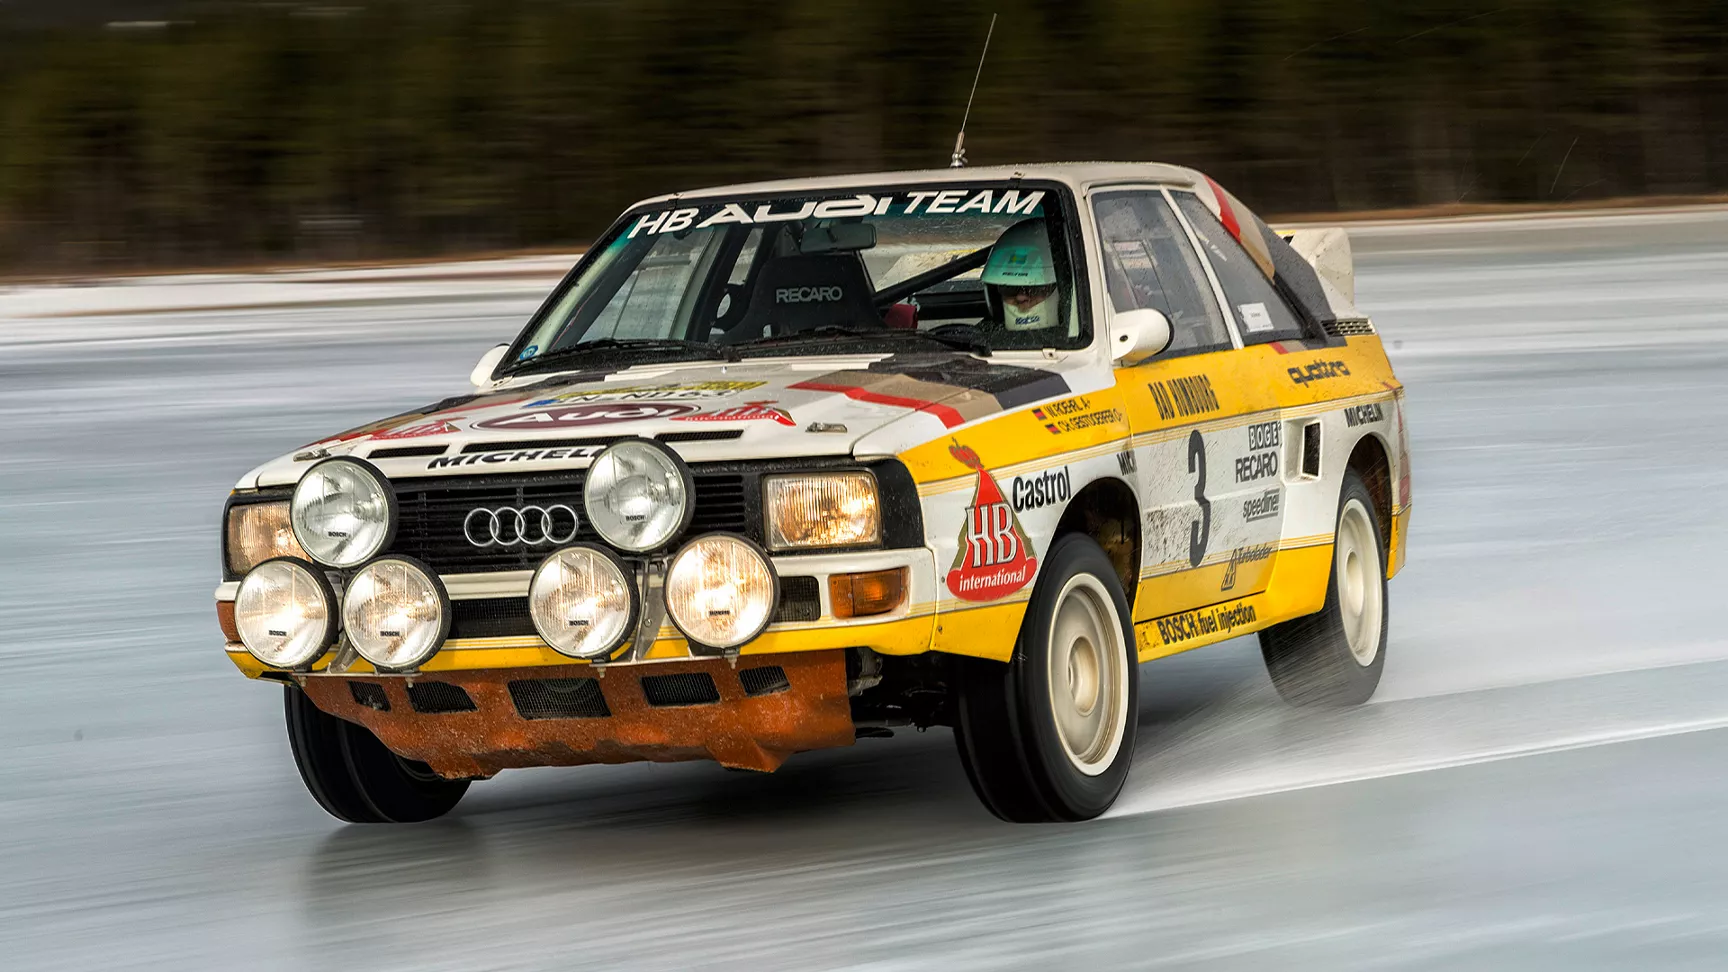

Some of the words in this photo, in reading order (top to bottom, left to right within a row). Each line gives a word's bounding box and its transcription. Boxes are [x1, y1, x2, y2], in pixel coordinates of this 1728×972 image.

[627, 206, 697, 239] HB
[903, 190, 1046, 216] TEAM
[775, 286, 843, 304] RECARO
[1287, 358, 1351, 389] quattro
[1147, 381, 1176, 421] BAD
[1344, 402, 1383, 428] MICHELIN
[1235, 451, 1278, 484] RECARO
[1012, 465, 1072, 514] Castrol
[1187, 429, 1211, 568] 3
[965, 502, 1017, 568] HB
[958, 565, 1027, 592] international
[569, 619, 589, 627] BOSCH
[1156, 610, 1200, 646] BOSCH
[1197, 609, 1219, 637] fuel
[1216, 601, 1257, 634] injection
